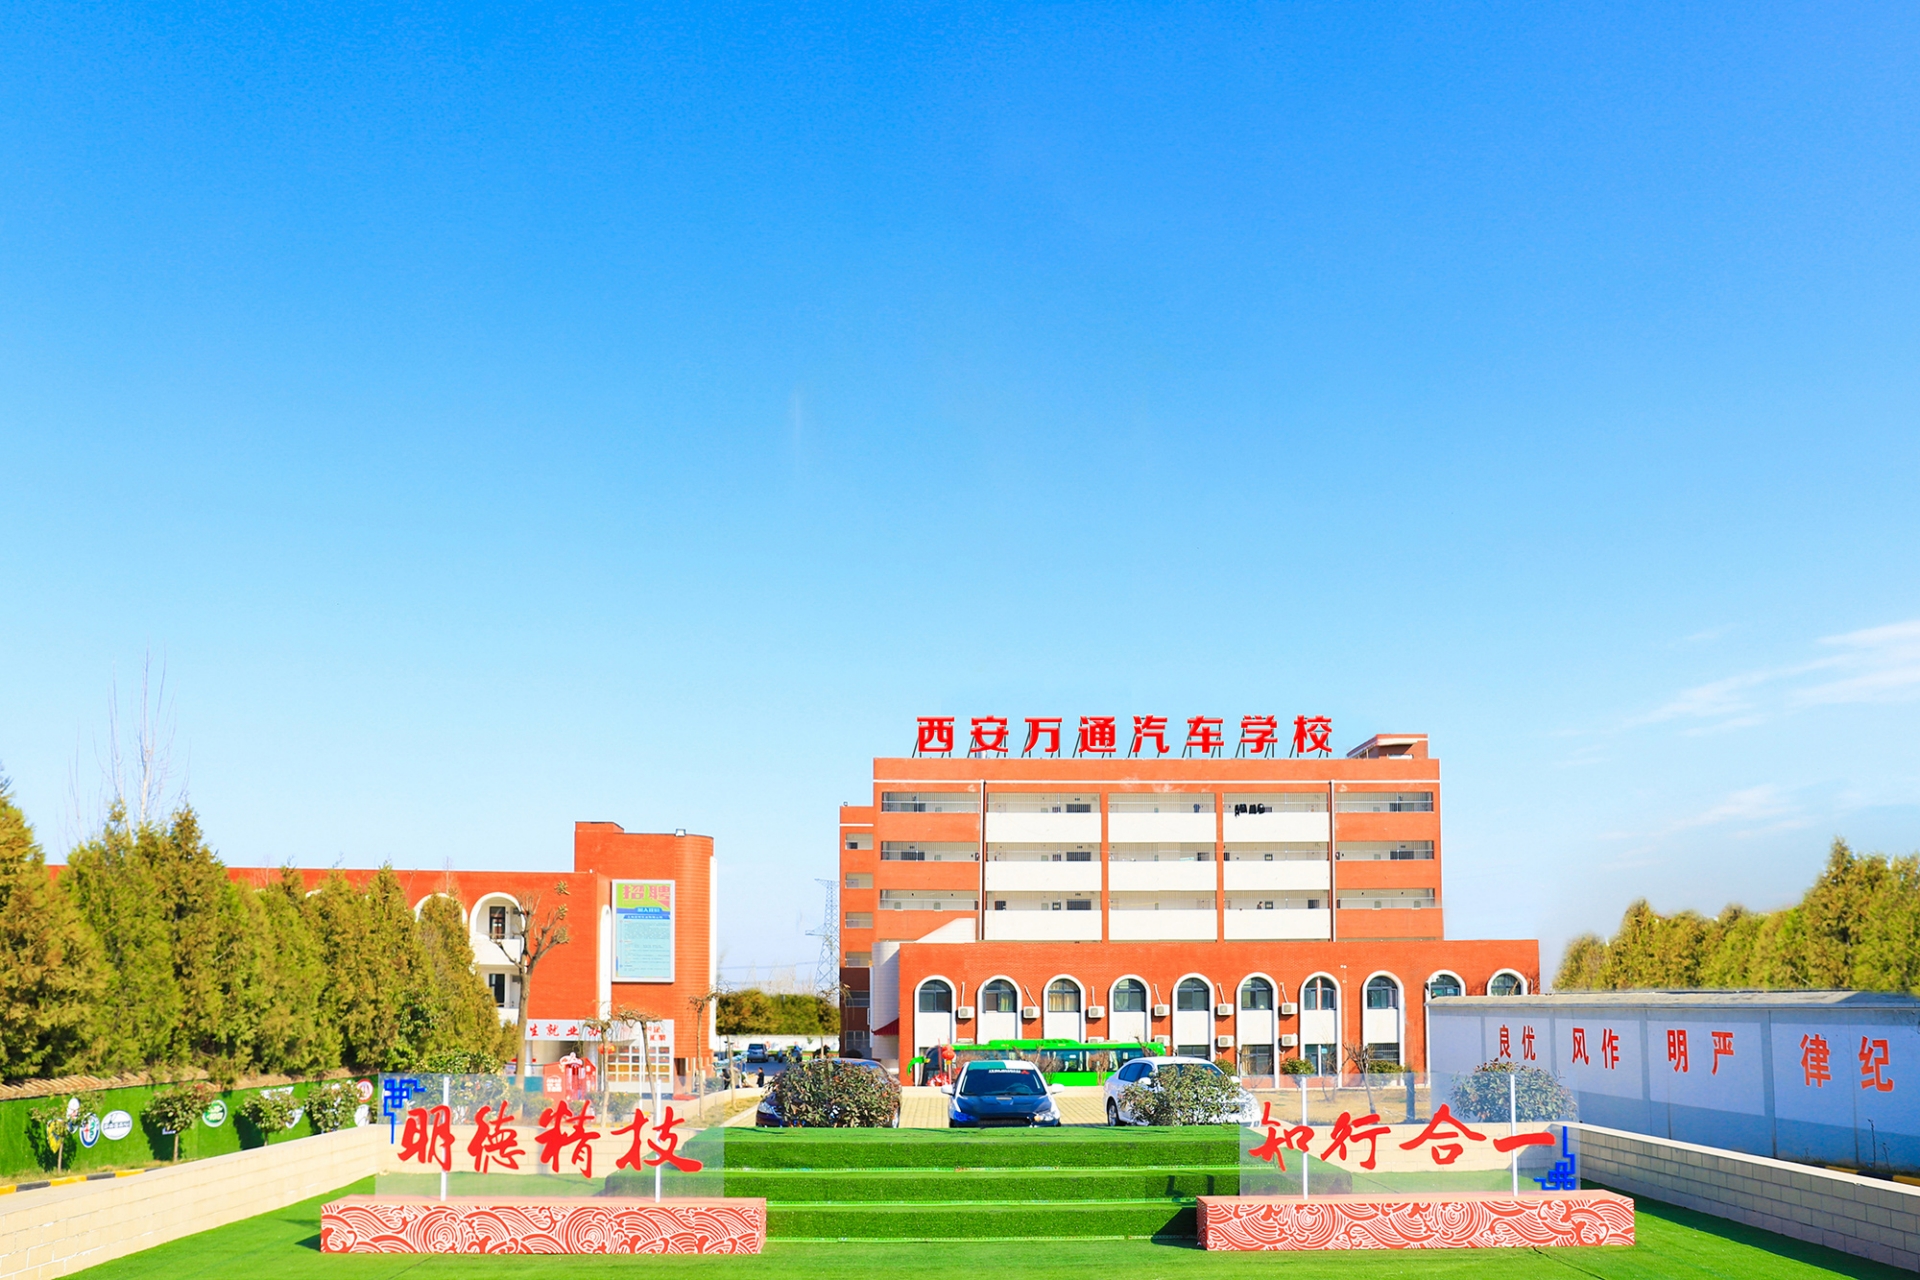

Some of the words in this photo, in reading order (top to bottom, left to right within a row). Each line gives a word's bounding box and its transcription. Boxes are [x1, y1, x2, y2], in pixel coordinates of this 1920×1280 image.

[916, 714, 1333, 754] 西安万通汽车学校
[623, 884, 671, 902] 招聘
[397, 1099, 704, 1179] 明德精技
[1247, 1100, 1558, 1173] 知行合一
